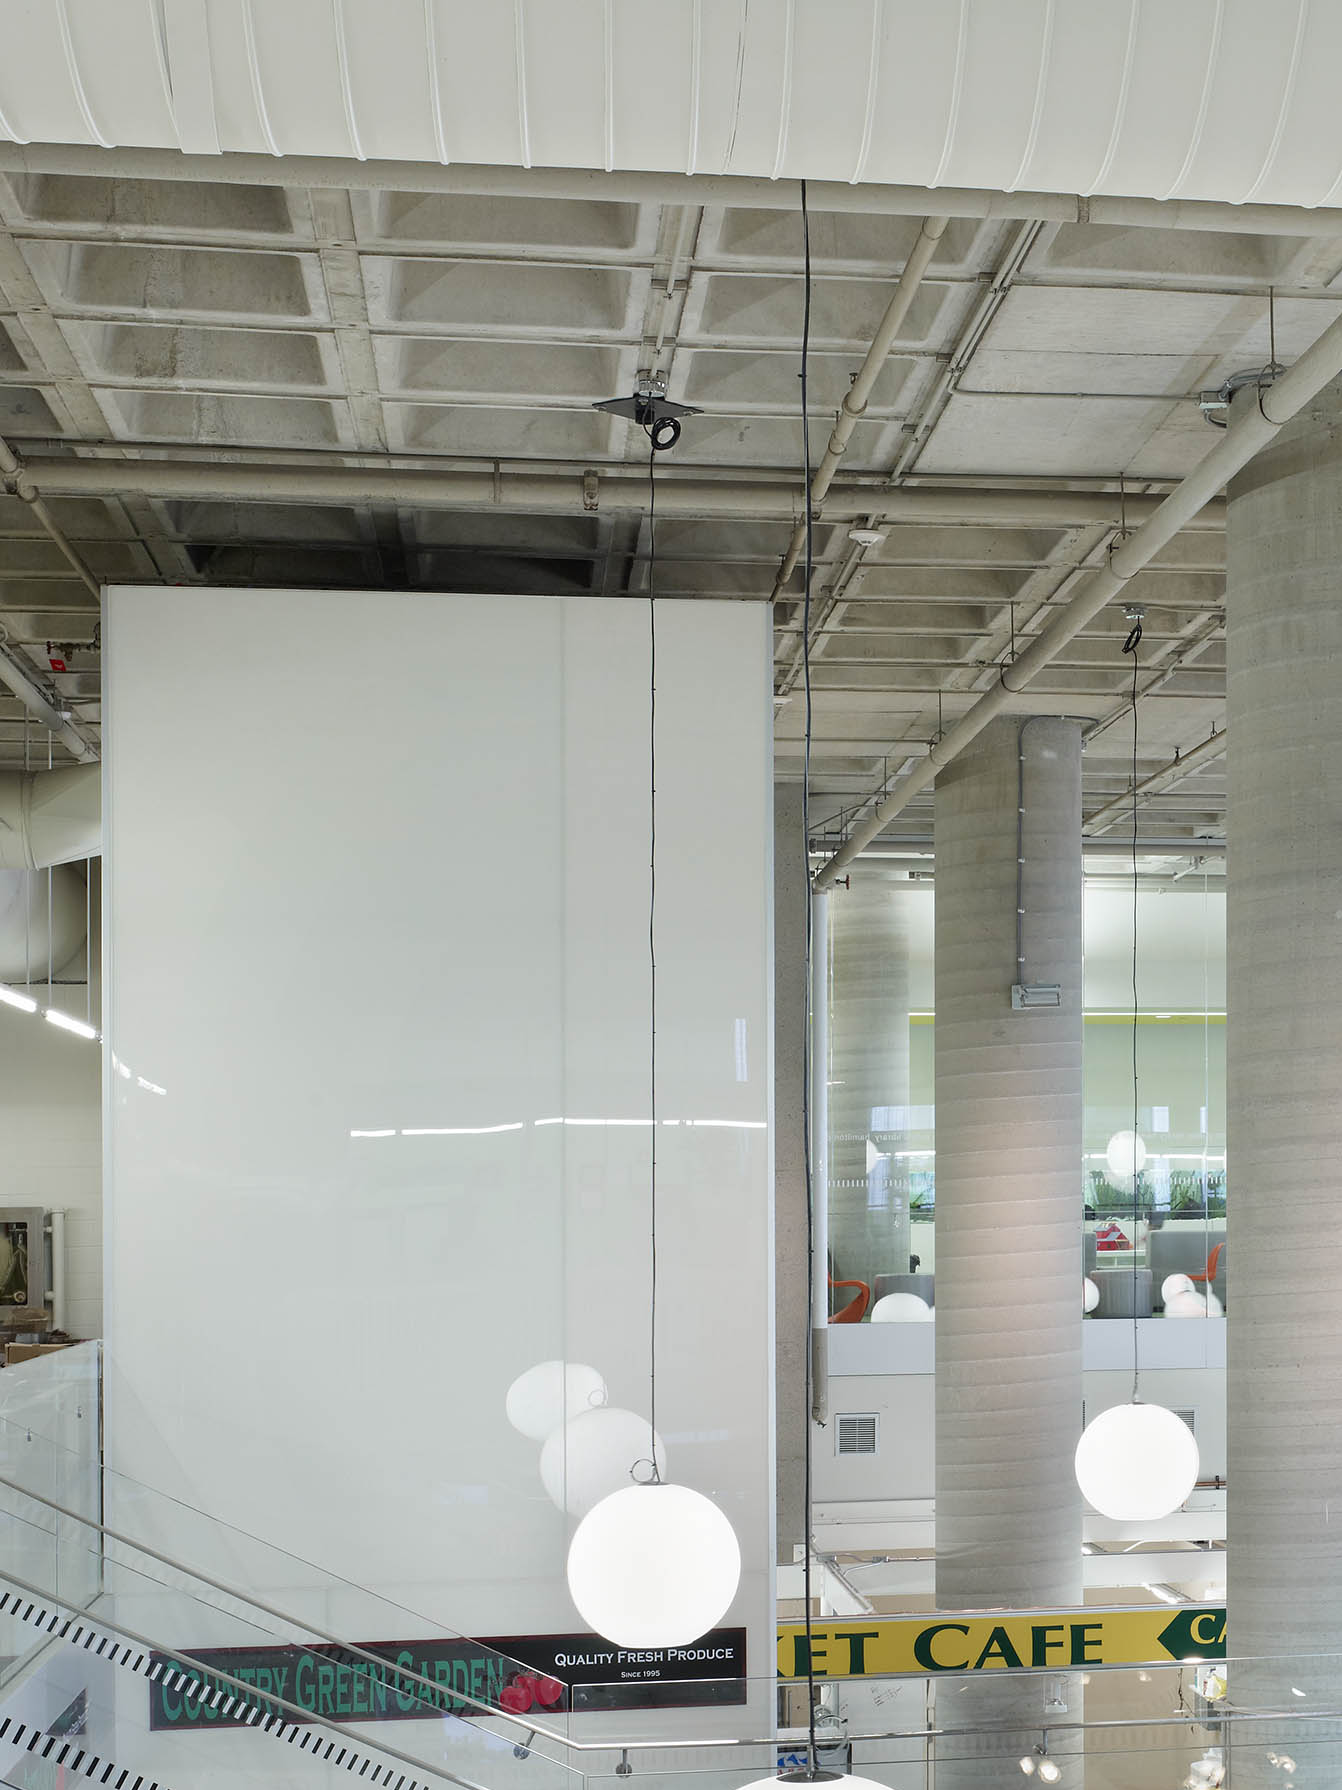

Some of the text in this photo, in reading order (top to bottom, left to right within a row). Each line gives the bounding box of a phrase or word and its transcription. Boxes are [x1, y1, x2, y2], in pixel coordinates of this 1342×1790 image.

[554, 1648, 734, 1668] QUALITY FRESH PRODUCE
[914, 1623, 1103, 1672] CAFE
[162, 1650, 504, 1721] COUNTRY GREEN GARDEN
